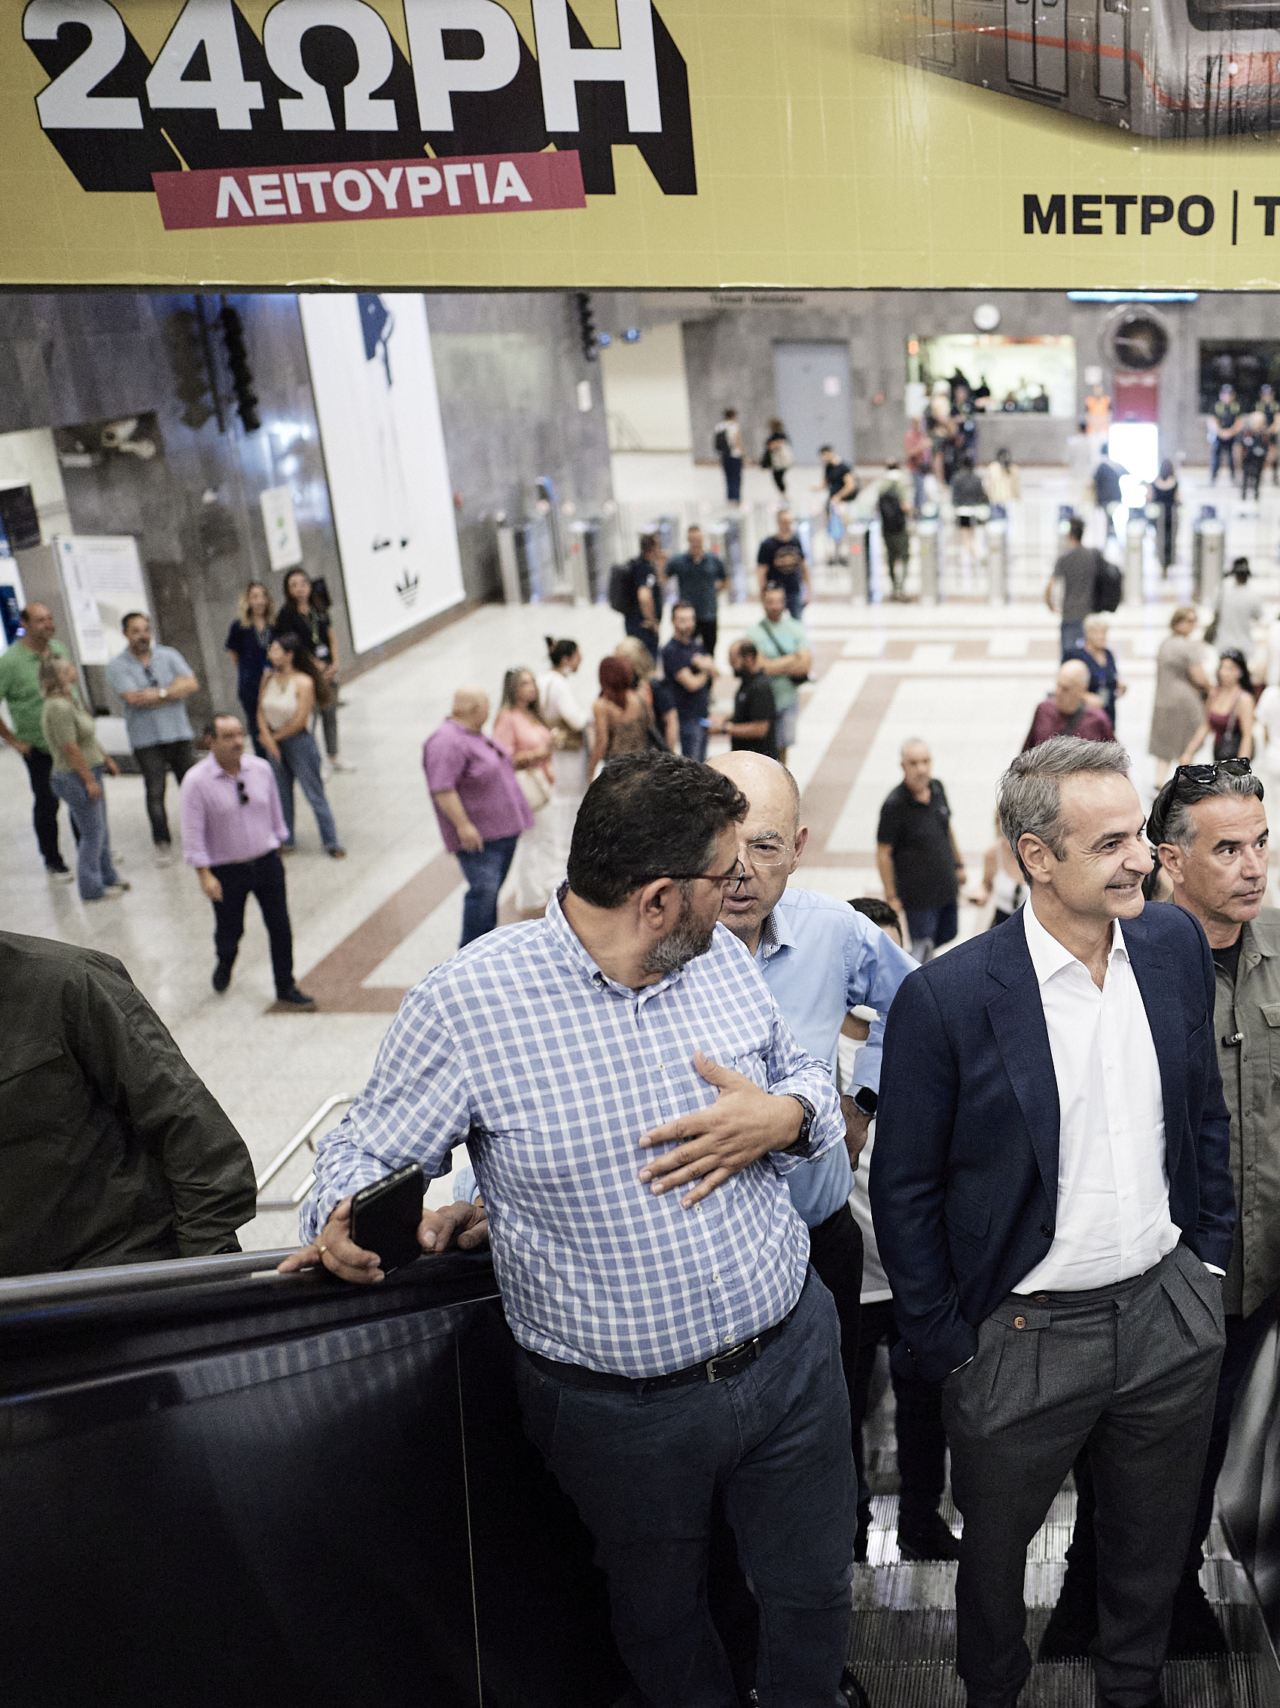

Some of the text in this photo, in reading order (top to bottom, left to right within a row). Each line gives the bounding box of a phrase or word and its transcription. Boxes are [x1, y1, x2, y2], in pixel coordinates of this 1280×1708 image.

[23, 0, 664, 133] 24ΩΡΗ
[215, 160, 533, 219] ΛΕΙΤΟΥΡΓΙΑ
[1023, 194, 1215, 236] ΜΕΤΡΟ
